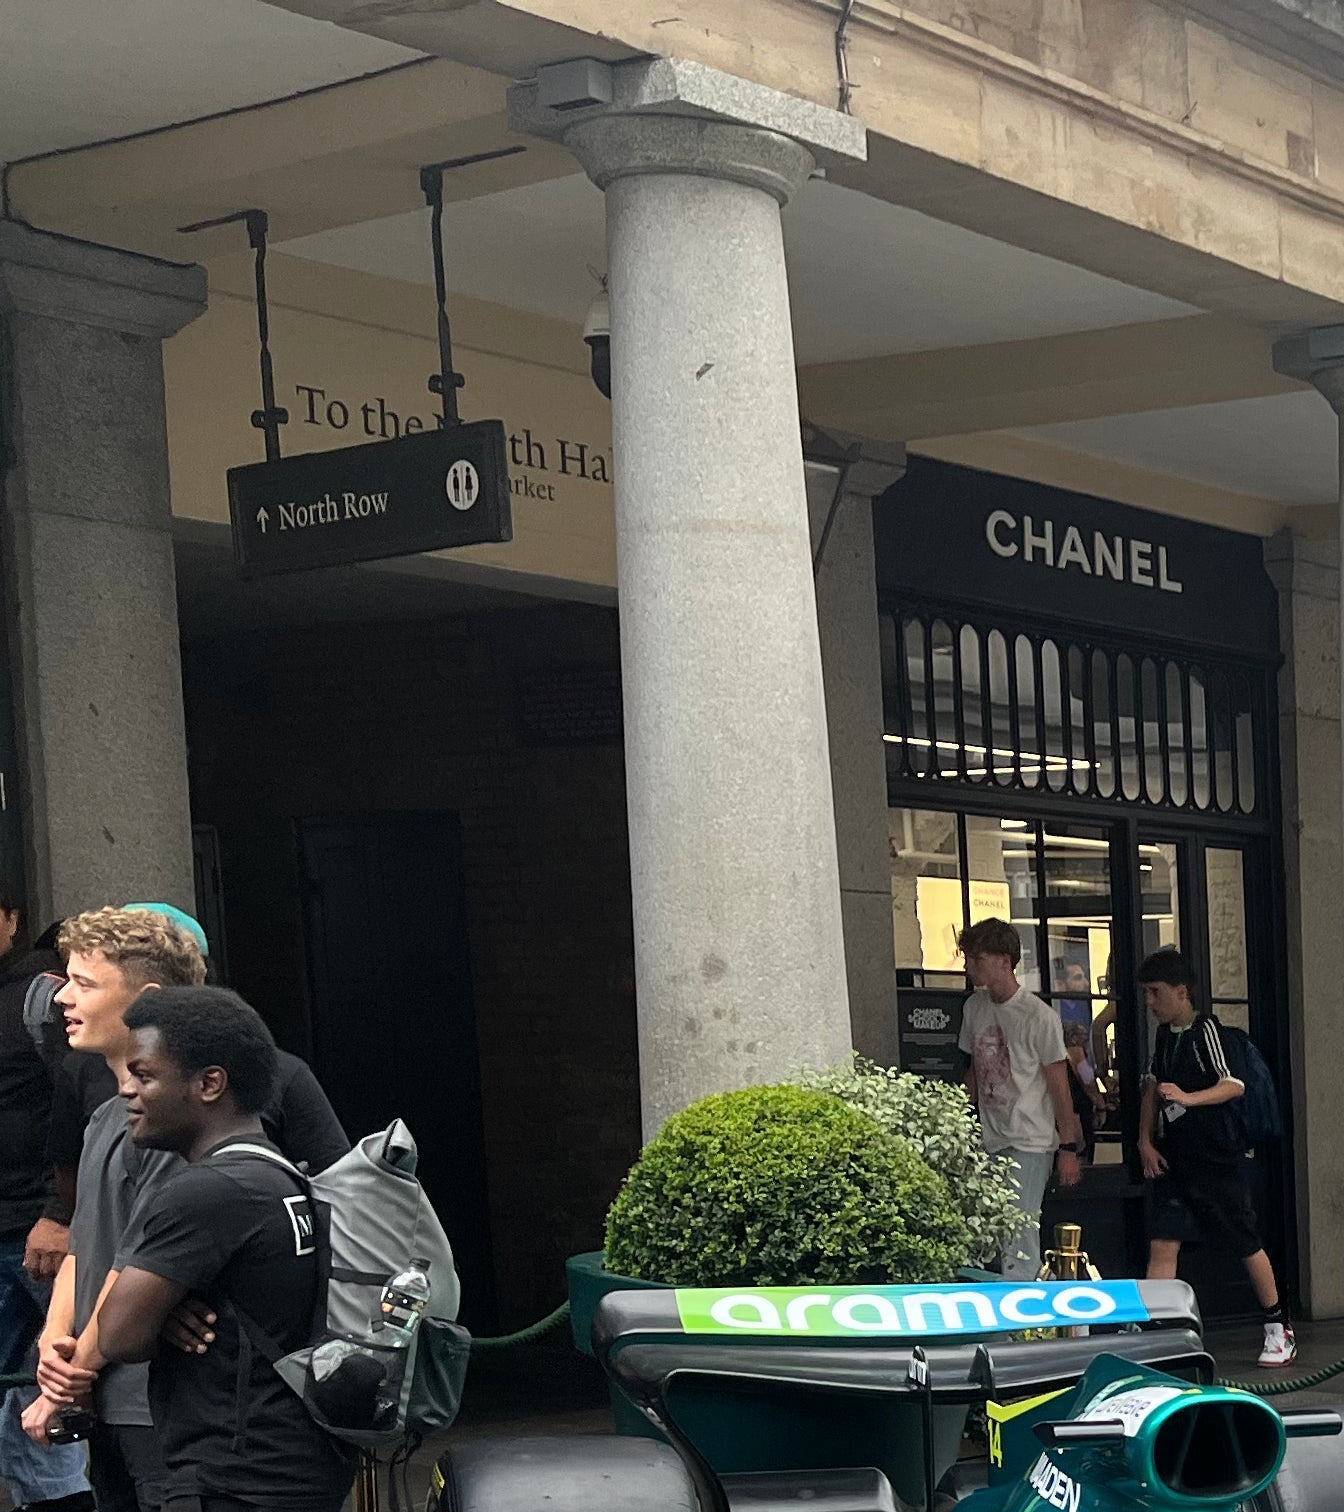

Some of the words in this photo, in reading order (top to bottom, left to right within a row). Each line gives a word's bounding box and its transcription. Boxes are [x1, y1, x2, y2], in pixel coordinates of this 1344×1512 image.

[295, 385, 349, 429] To
[361, 398, 424, 438] the
[556, 438, 614, 484] Ha
[508, 474, 555, 501] rket
[278, 494, 340, 531] North
[344, 491, 389, 519] Row
[985, 509, 1183, 593] CHANEL
[711, 1286, 1116, 1331] aramco
